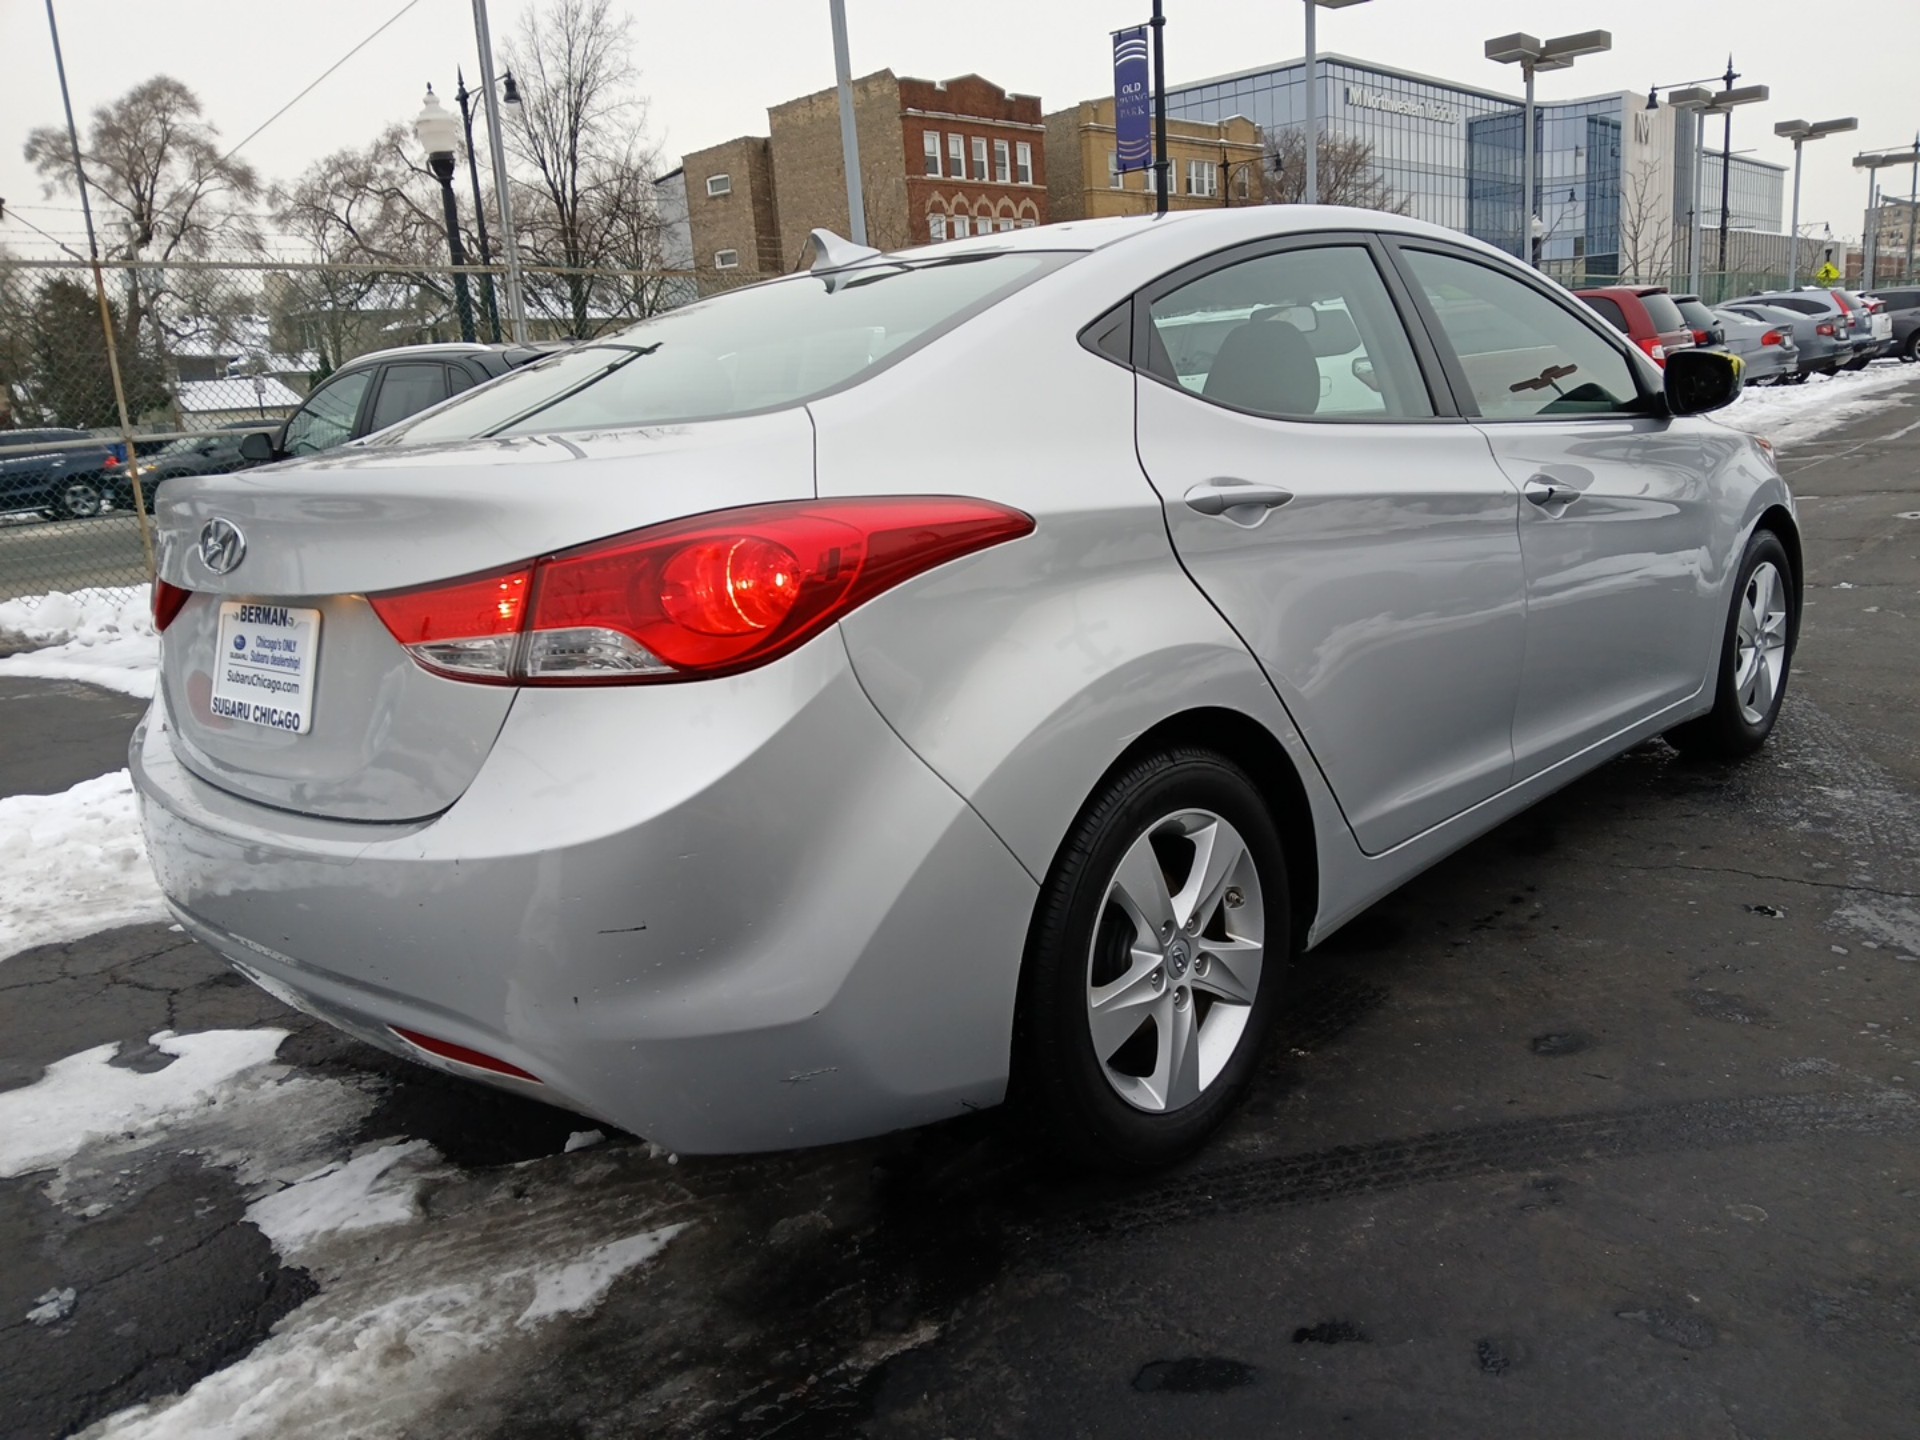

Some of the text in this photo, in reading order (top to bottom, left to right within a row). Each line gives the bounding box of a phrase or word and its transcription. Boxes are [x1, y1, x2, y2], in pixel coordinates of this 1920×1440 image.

[1122, 82, 1141, 94] OLD
[1363, 89, 1424, 116] Northwestern
[1426, 102, 1460, 124] Medicine
[240, 604, 288, 627] BERMAN
[256, 635, 297, 653] Chicago's ONLY
[250, 650, 269, 665] Subaru
[227, 669, 300, 694] SubaruChicago.com
[212, 697, 300, 732] SUBARU CHICAGO
